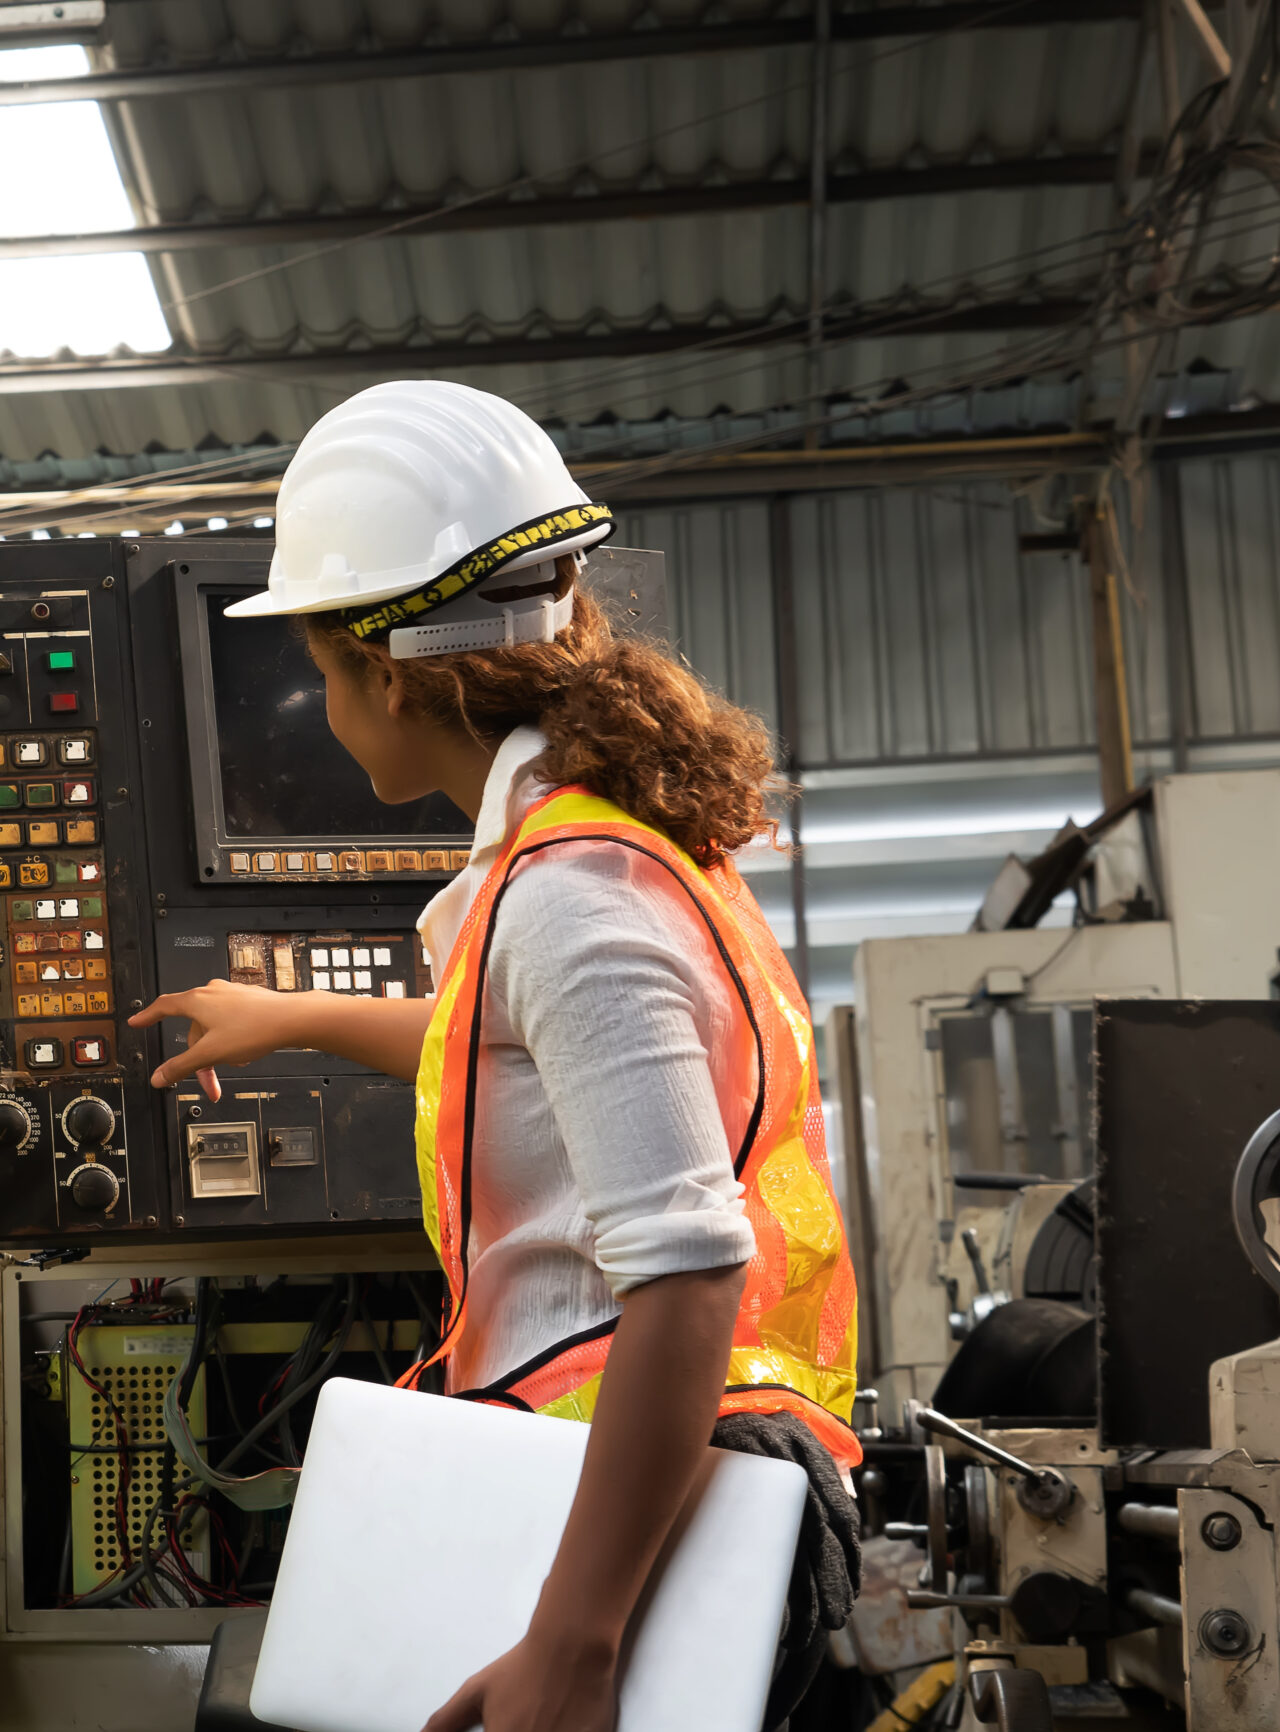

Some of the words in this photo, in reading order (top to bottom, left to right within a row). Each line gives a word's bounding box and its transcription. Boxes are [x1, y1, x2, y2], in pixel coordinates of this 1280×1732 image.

[375, 857, 385, 865] F5
[403, 856, 414, 864] F6
[431, 856, 441, 864] F7
[73, 1003, 83, 1011] 25
[90, 1001, 106, 1010] 100
